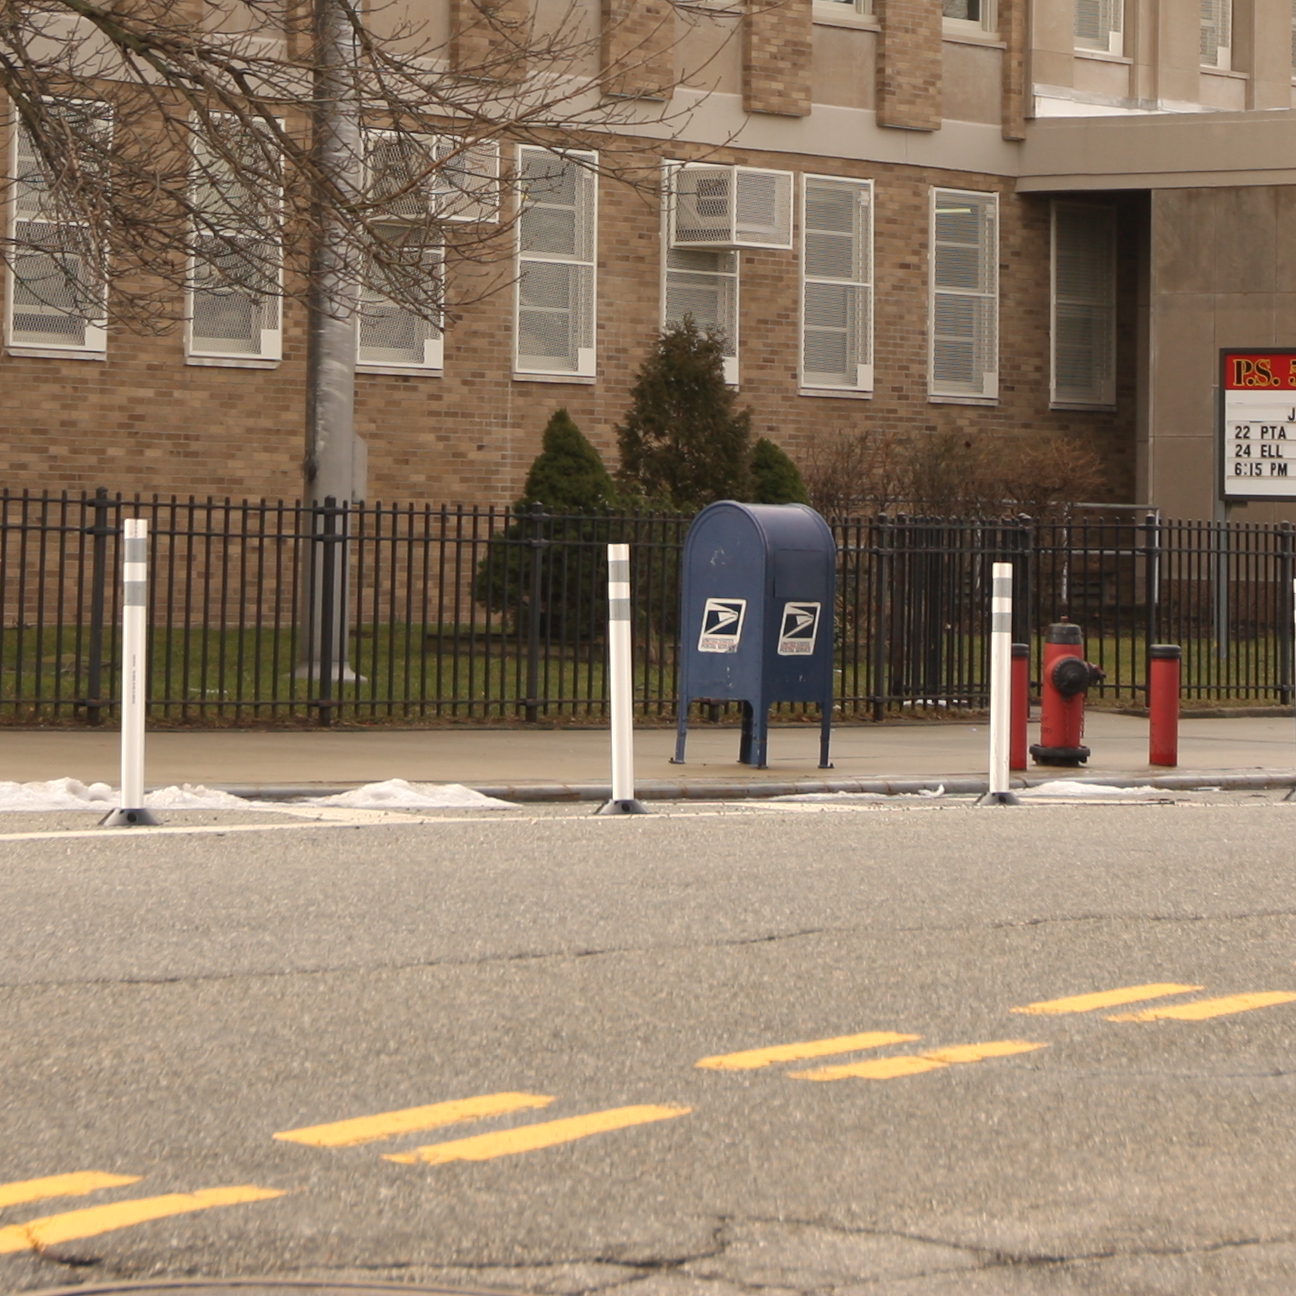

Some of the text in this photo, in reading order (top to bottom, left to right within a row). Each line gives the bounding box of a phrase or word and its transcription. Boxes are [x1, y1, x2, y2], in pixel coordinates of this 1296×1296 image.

[1233, 359, 1281, 386] P.S.
[1234, 426, 1251, 440] 22
[1260, 426, 1287, 440] PTA
[1234, 444, 1251, 458] 24
[1260, 444, 1283, 458] ELL
[1234, 462, 1288, 477] 6:15 PM
